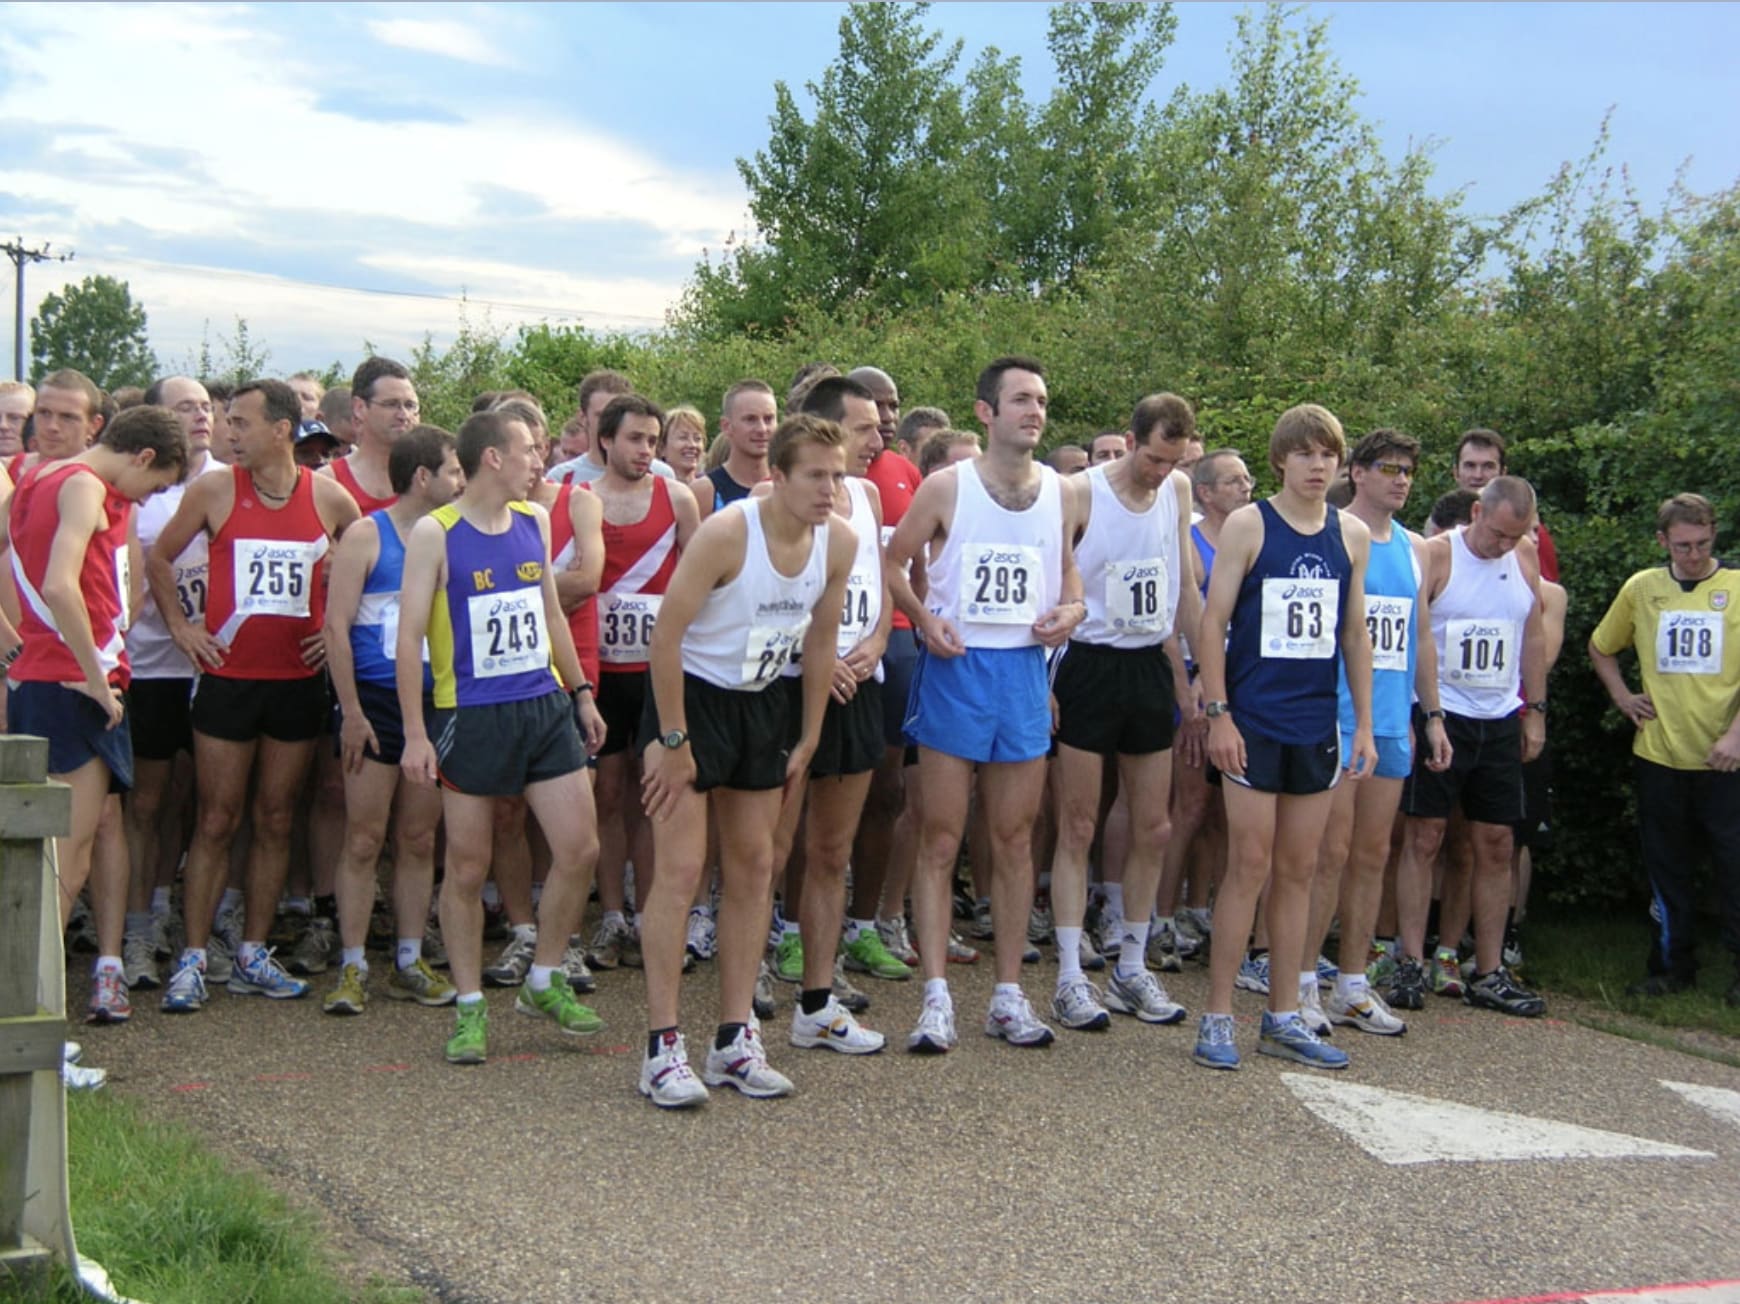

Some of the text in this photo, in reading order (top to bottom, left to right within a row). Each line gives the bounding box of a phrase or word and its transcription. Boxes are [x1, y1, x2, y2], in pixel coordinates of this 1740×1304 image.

[185, 562, 209, 577] asic
[249, 560, 303, 597] 255
[473, 568, 495, 592] BC
[975, 565, 1028, 604] 293
[1129, 580, 1157, 616] 18
[486, 611, 539, 656] 243
[604, 612, 656, 647] 336
[1287, 601, 1323, 639] 63
[1366, 616, 1406, 652] 302
[1459, 638, 1505, 671] 104
[1667, 627, 1711, 658] 198
